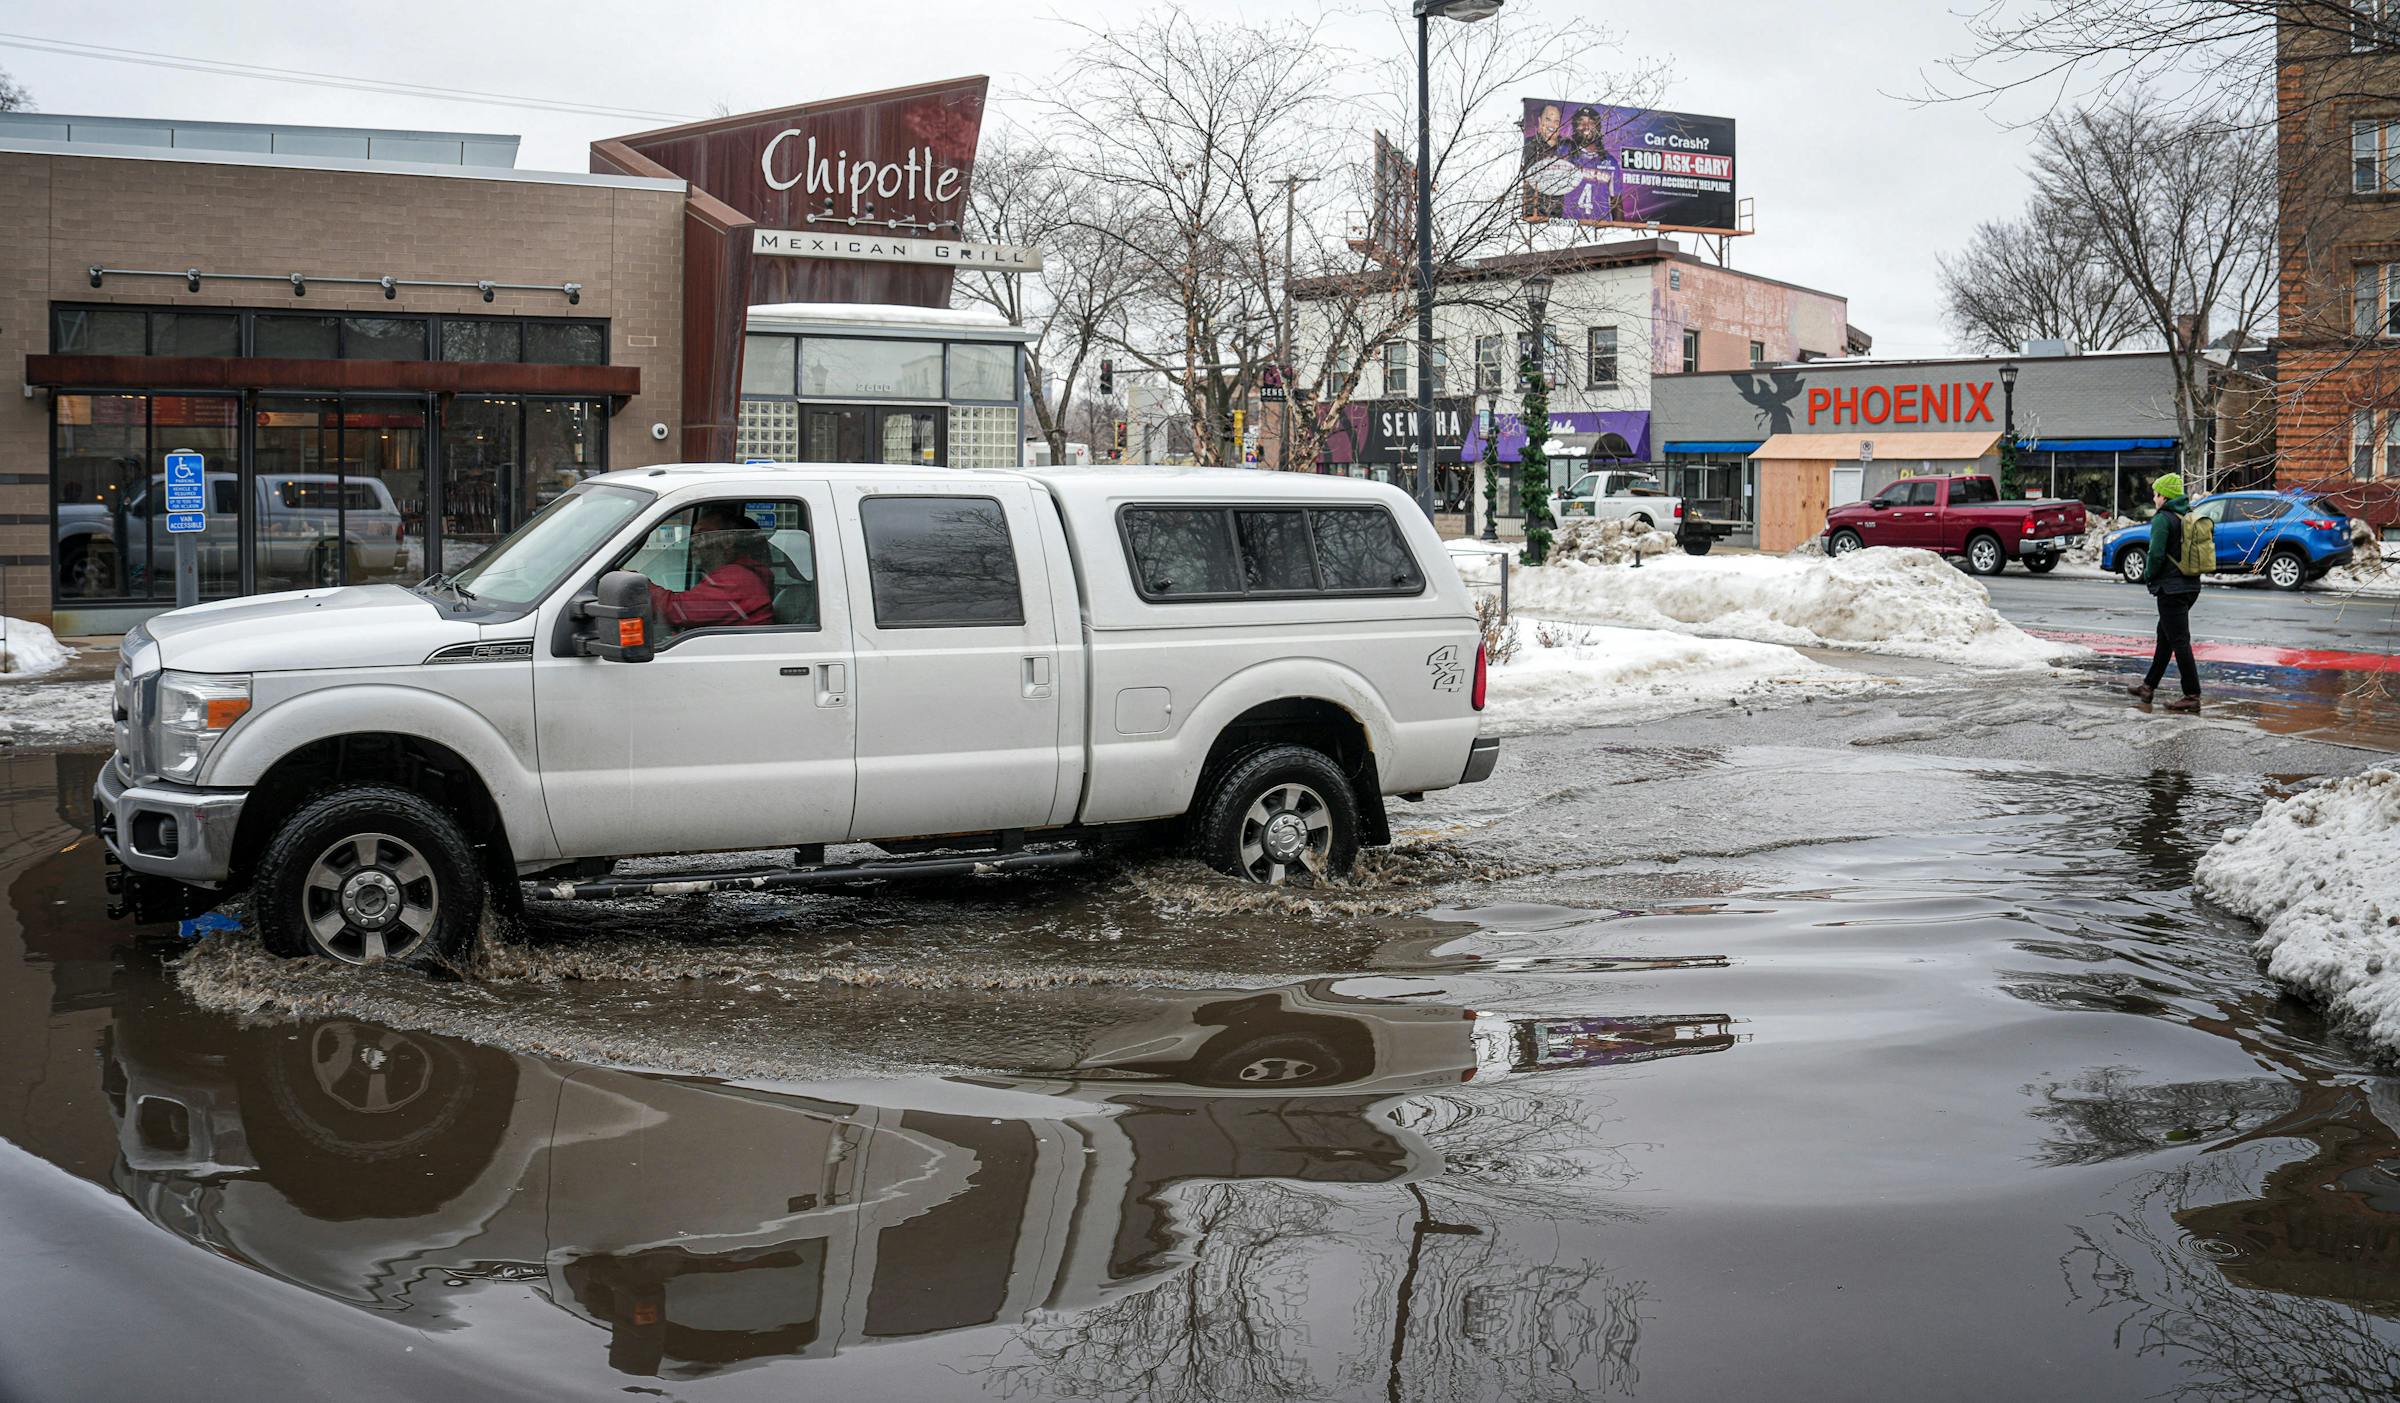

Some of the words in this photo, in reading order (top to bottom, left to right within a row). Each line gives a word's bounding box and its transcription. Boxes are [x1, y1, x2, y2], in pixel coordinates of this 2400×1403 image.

[1644, 132, 1667, 146] Car
[1668, 135, 1710, 150] Crash?
[761, 128, 962, 214] Chipotle
[1621, 149, 1662, 171] 1-800
[1663, 153, 1730, 177] ASK-GARY
[1622, 173, 1641, 184] FREE
[1641, 174, 1661, 187] AUTO
[1661, 176, 1699, 189] ACCIDENT
[1699, 180, 1731, 193] HELPLINE
[1577, 183, 1594, 215] 4
[761, 235, 906, 256] MEXICAN
[935, 245, 1024, 263] GRILL
[1807, 381, 1994, 426] PHOENIX
[1382, 410, 1461, 437] SENHA
